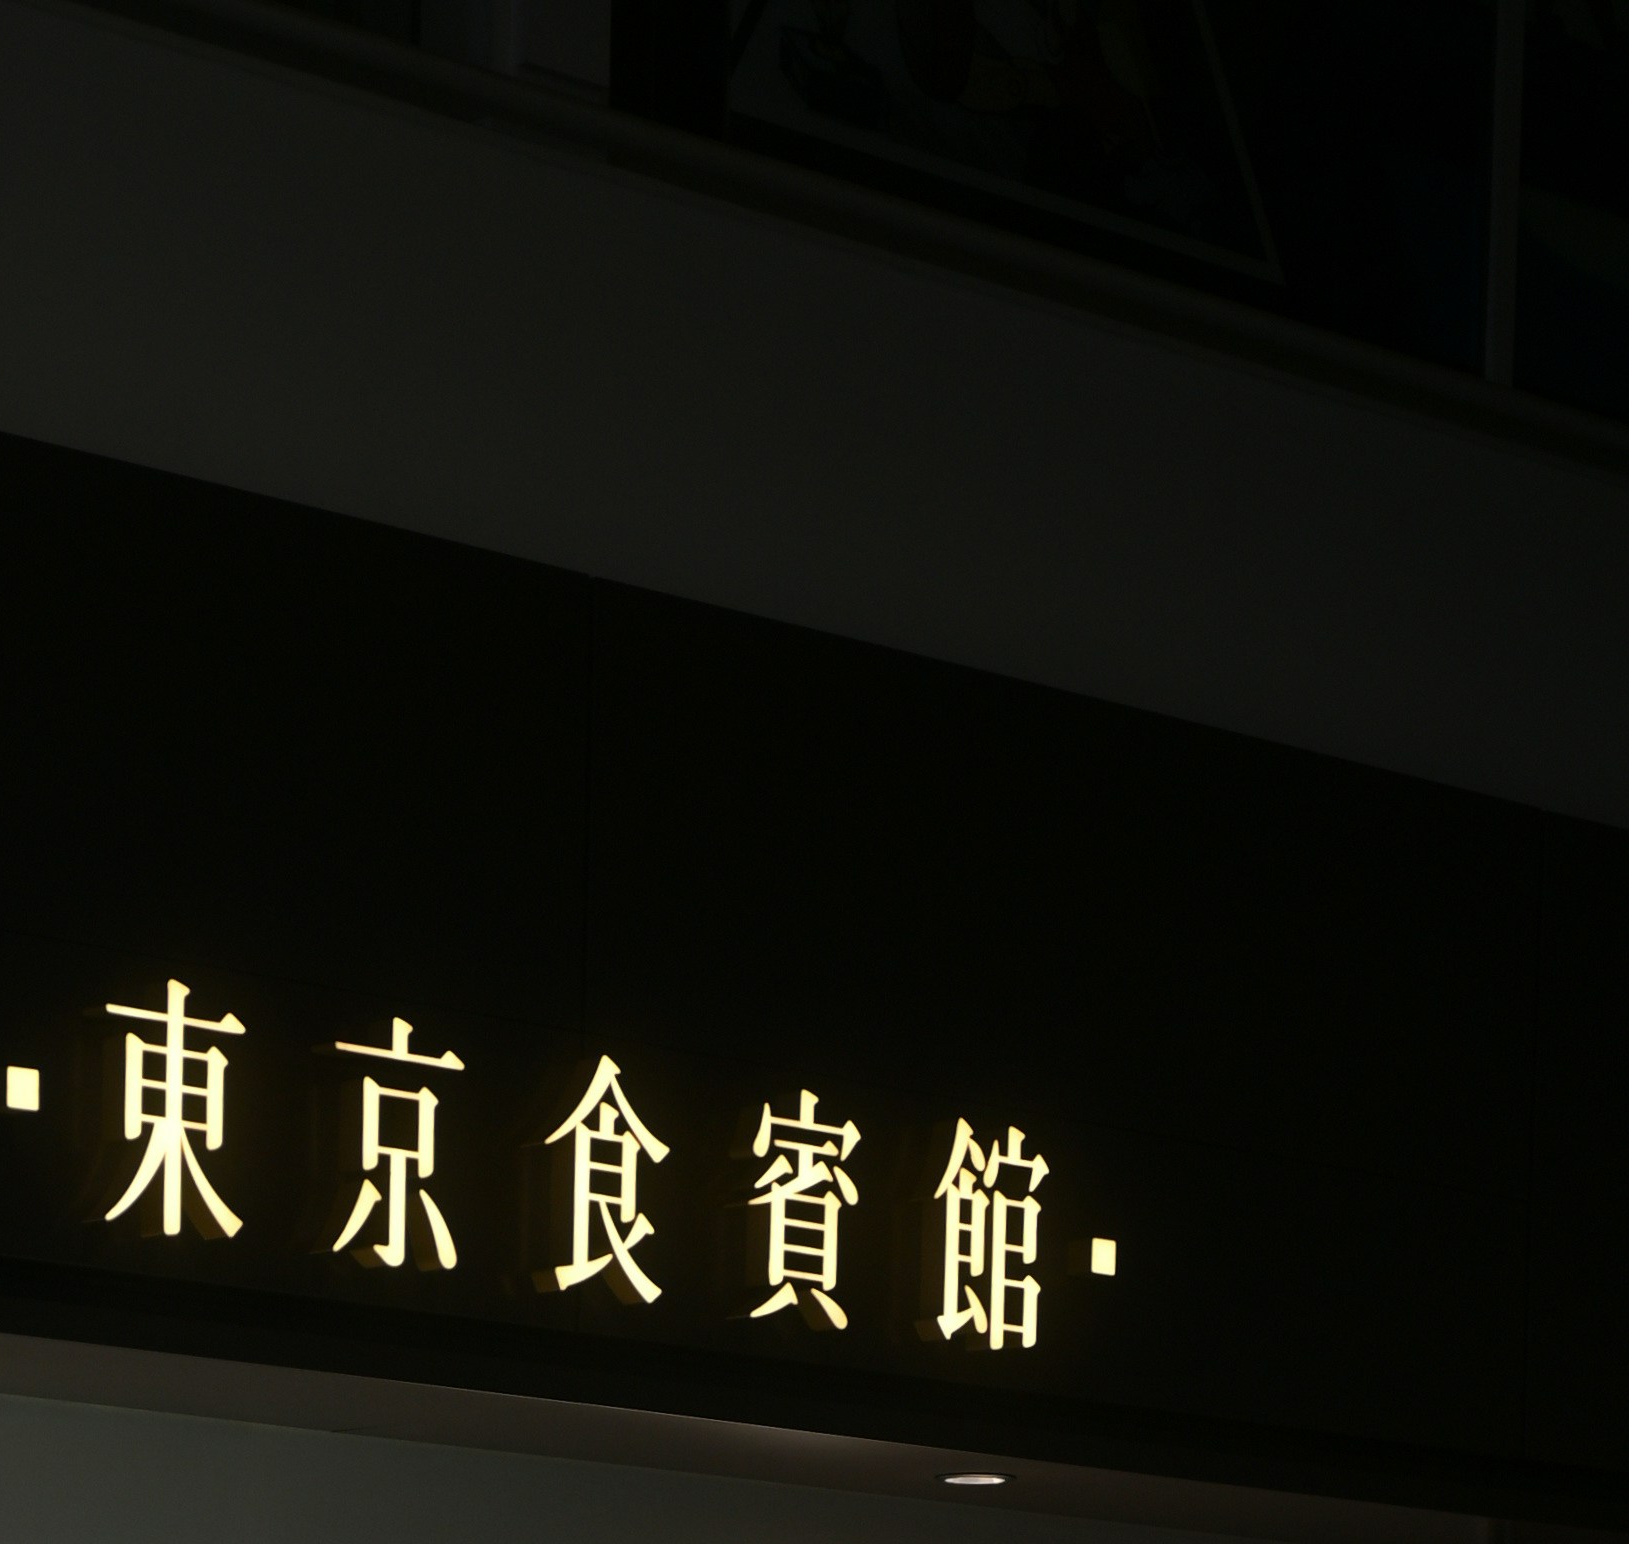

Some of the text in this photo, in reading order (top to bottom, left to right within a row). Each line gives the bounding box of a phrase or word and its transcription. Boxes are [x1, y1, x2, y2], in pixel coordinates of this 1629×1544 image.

[103, 978, 1049, 1350] 東京食賓館
